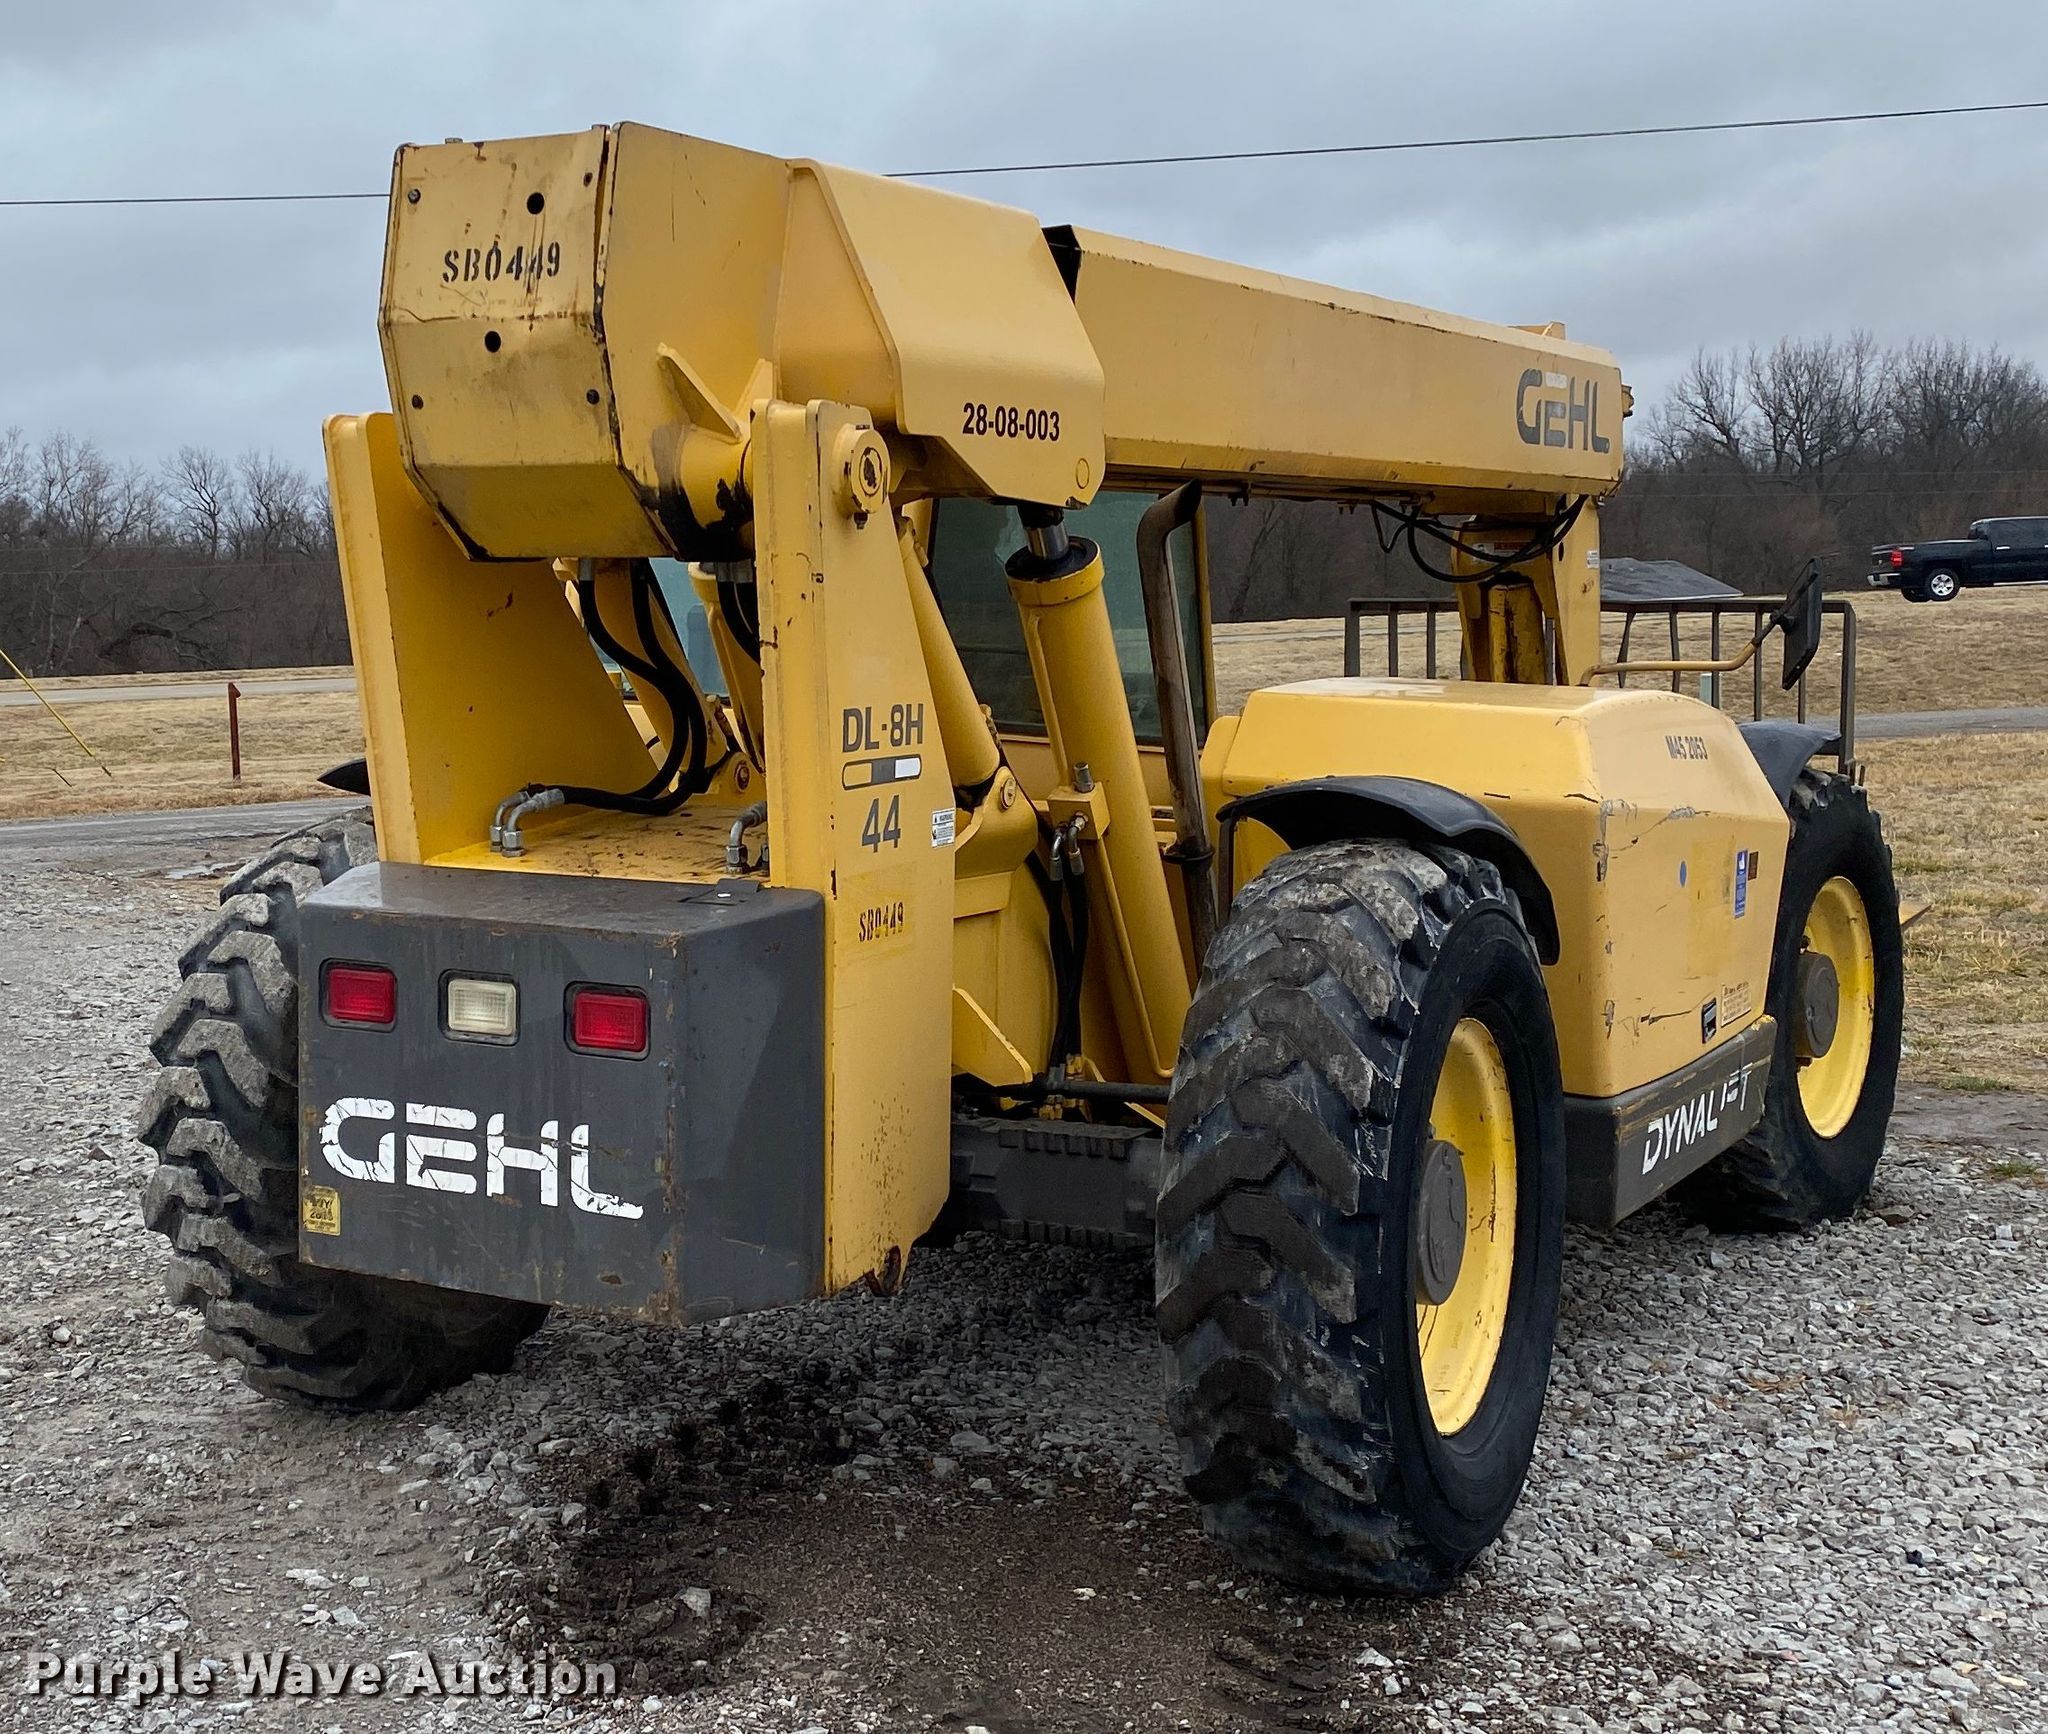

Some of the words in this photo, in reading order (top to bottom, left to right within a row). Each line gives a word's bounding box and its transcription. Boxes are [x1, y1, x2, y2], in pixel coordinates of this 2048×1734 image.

[442, 241, 560, 283] SB0449
[962, 402, 1060, 441] 28-08-003
[1516, 368, 1610, 454] GEHL
[862, 795, 902, 853] 44
[319, 1097, 644, 1220] GEHL
